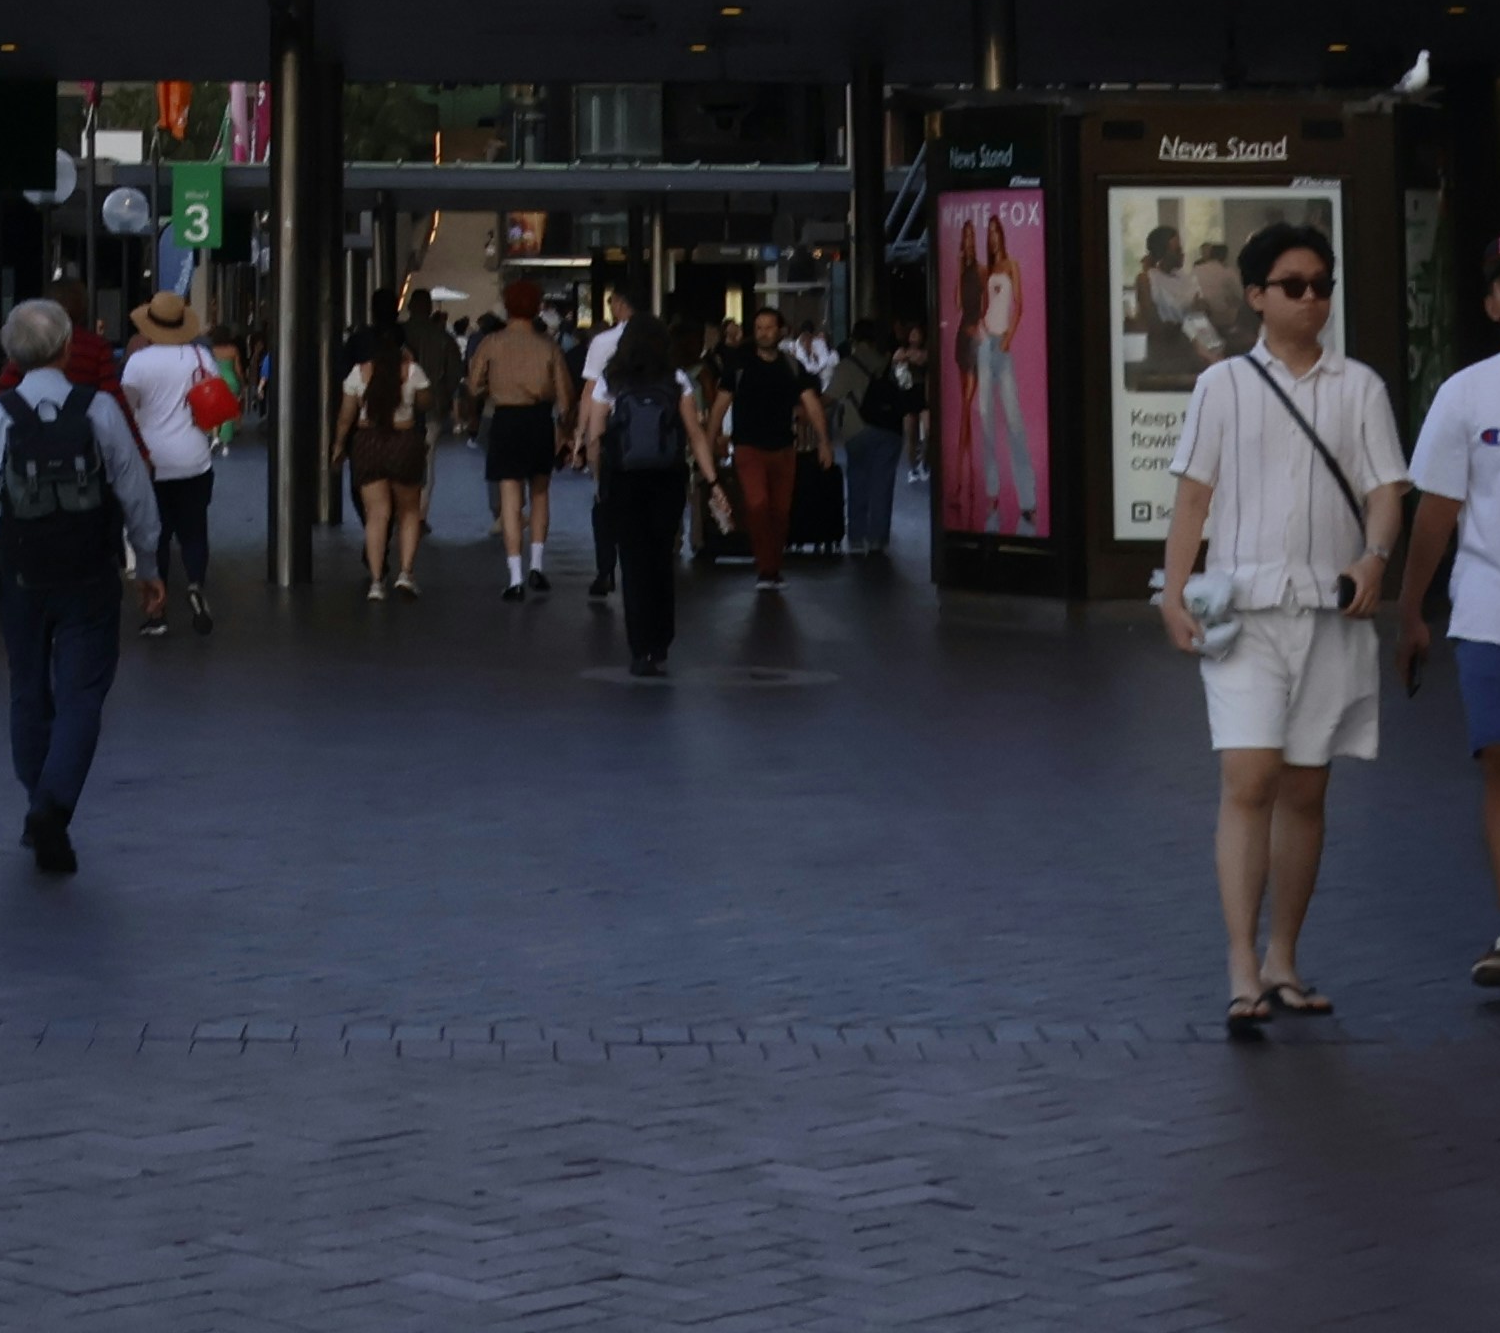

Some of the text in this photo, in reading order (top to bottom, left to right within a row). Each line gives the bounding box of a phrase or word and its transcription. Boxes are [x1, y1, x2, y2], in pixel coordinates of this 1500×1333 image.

[949, 143, 1013, 169] News Stand
[1159, 134, 1288, 161] News Stand
[183, 203, 210, 243] 3
[999, 201, 1040, 227] FOX
[1130, 409, 1177, 429] Keep
